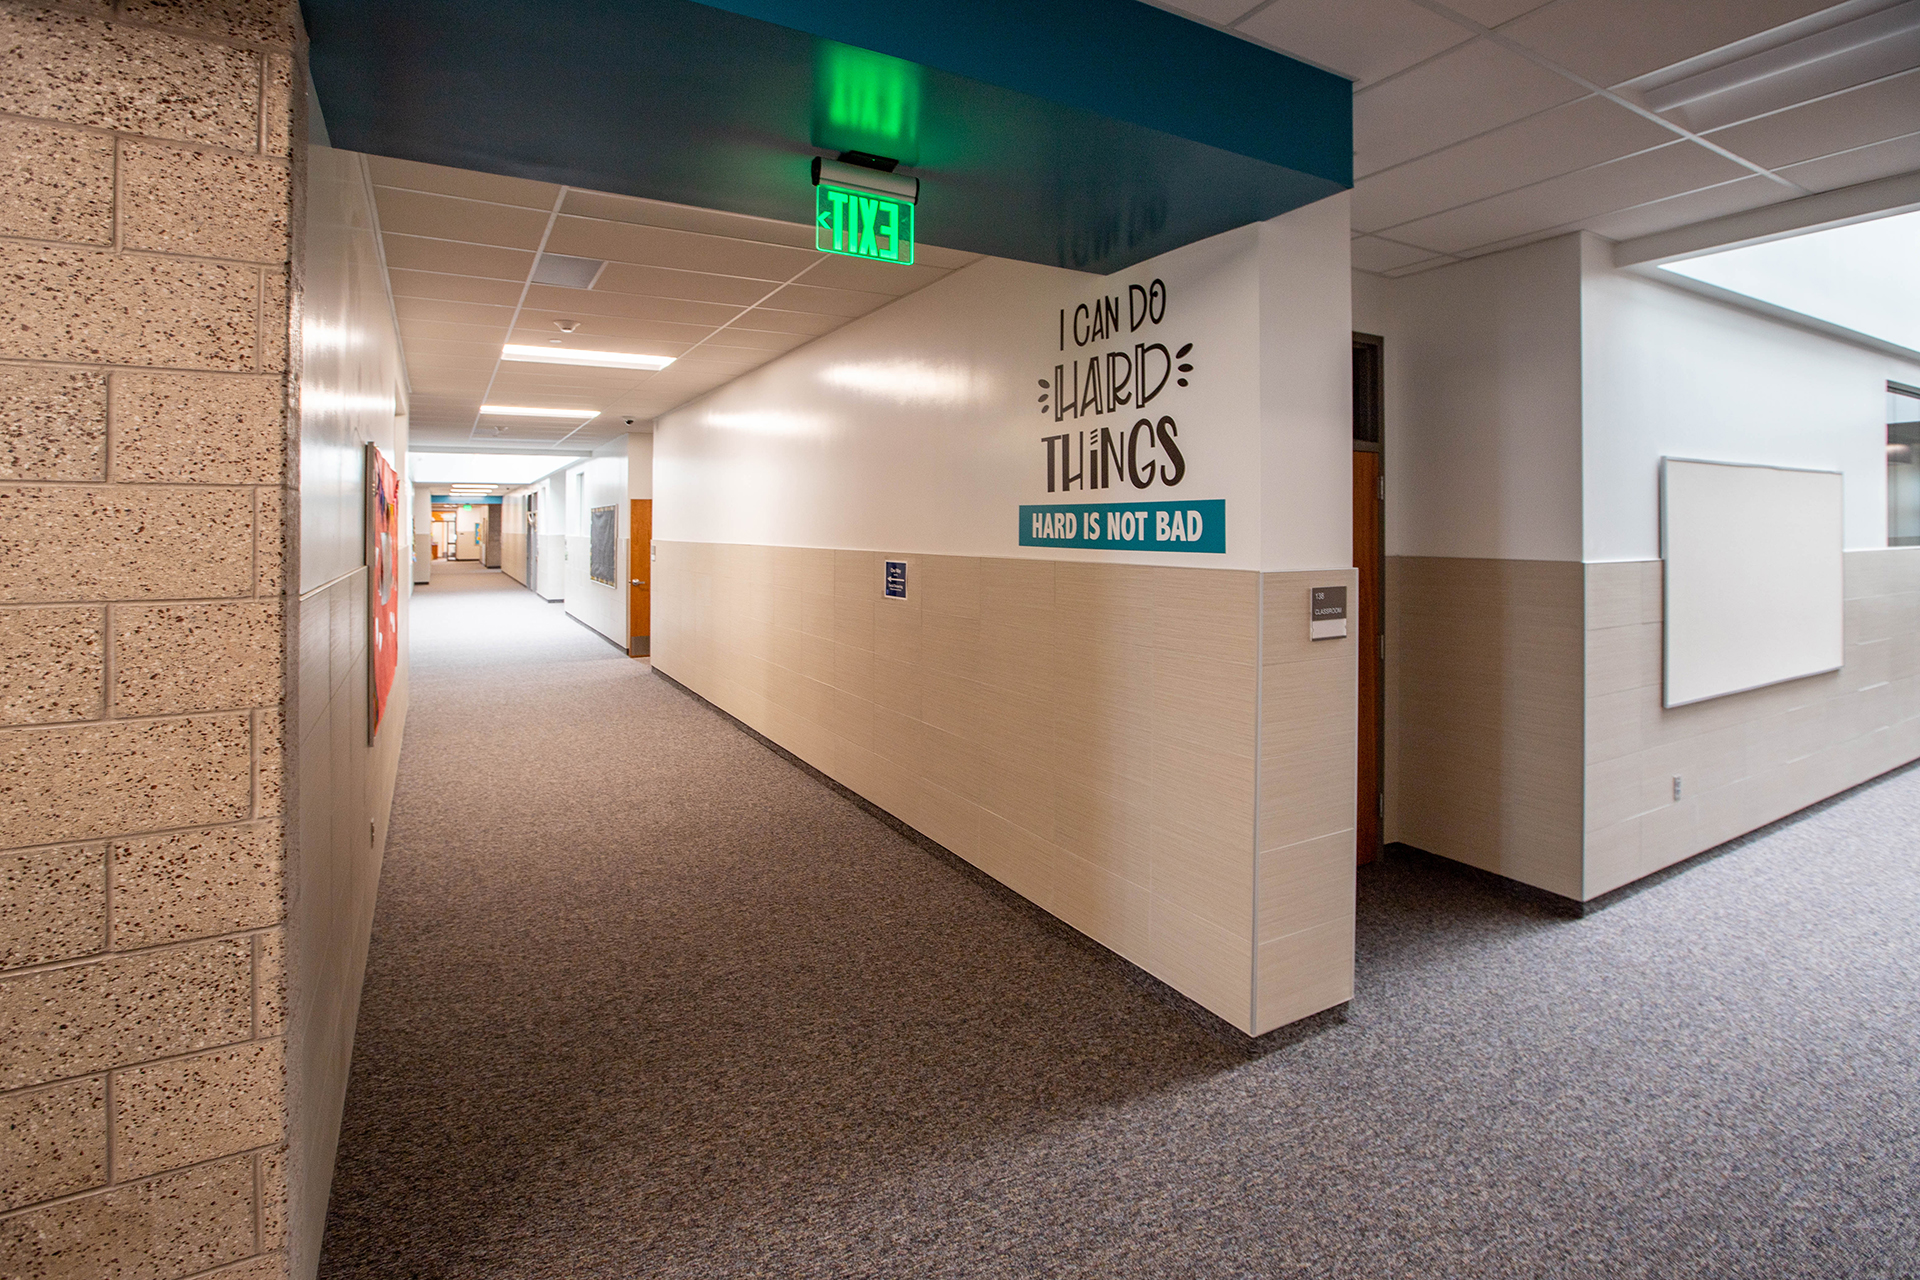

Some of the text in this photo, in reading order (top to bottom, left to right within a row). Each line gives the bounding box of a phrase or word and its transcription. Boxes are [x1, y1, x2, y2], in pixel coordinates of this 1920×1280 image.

[1060, 278, 1167, 351] I CAN DO
[1054, 342, 1172, 422] HARD
[1040, 415, 1186, 493] THINGS
[1032, 510, 1203, 542] HARD IS NOT BAD
[1314, 607, 1343, 615] CLASSROOM
